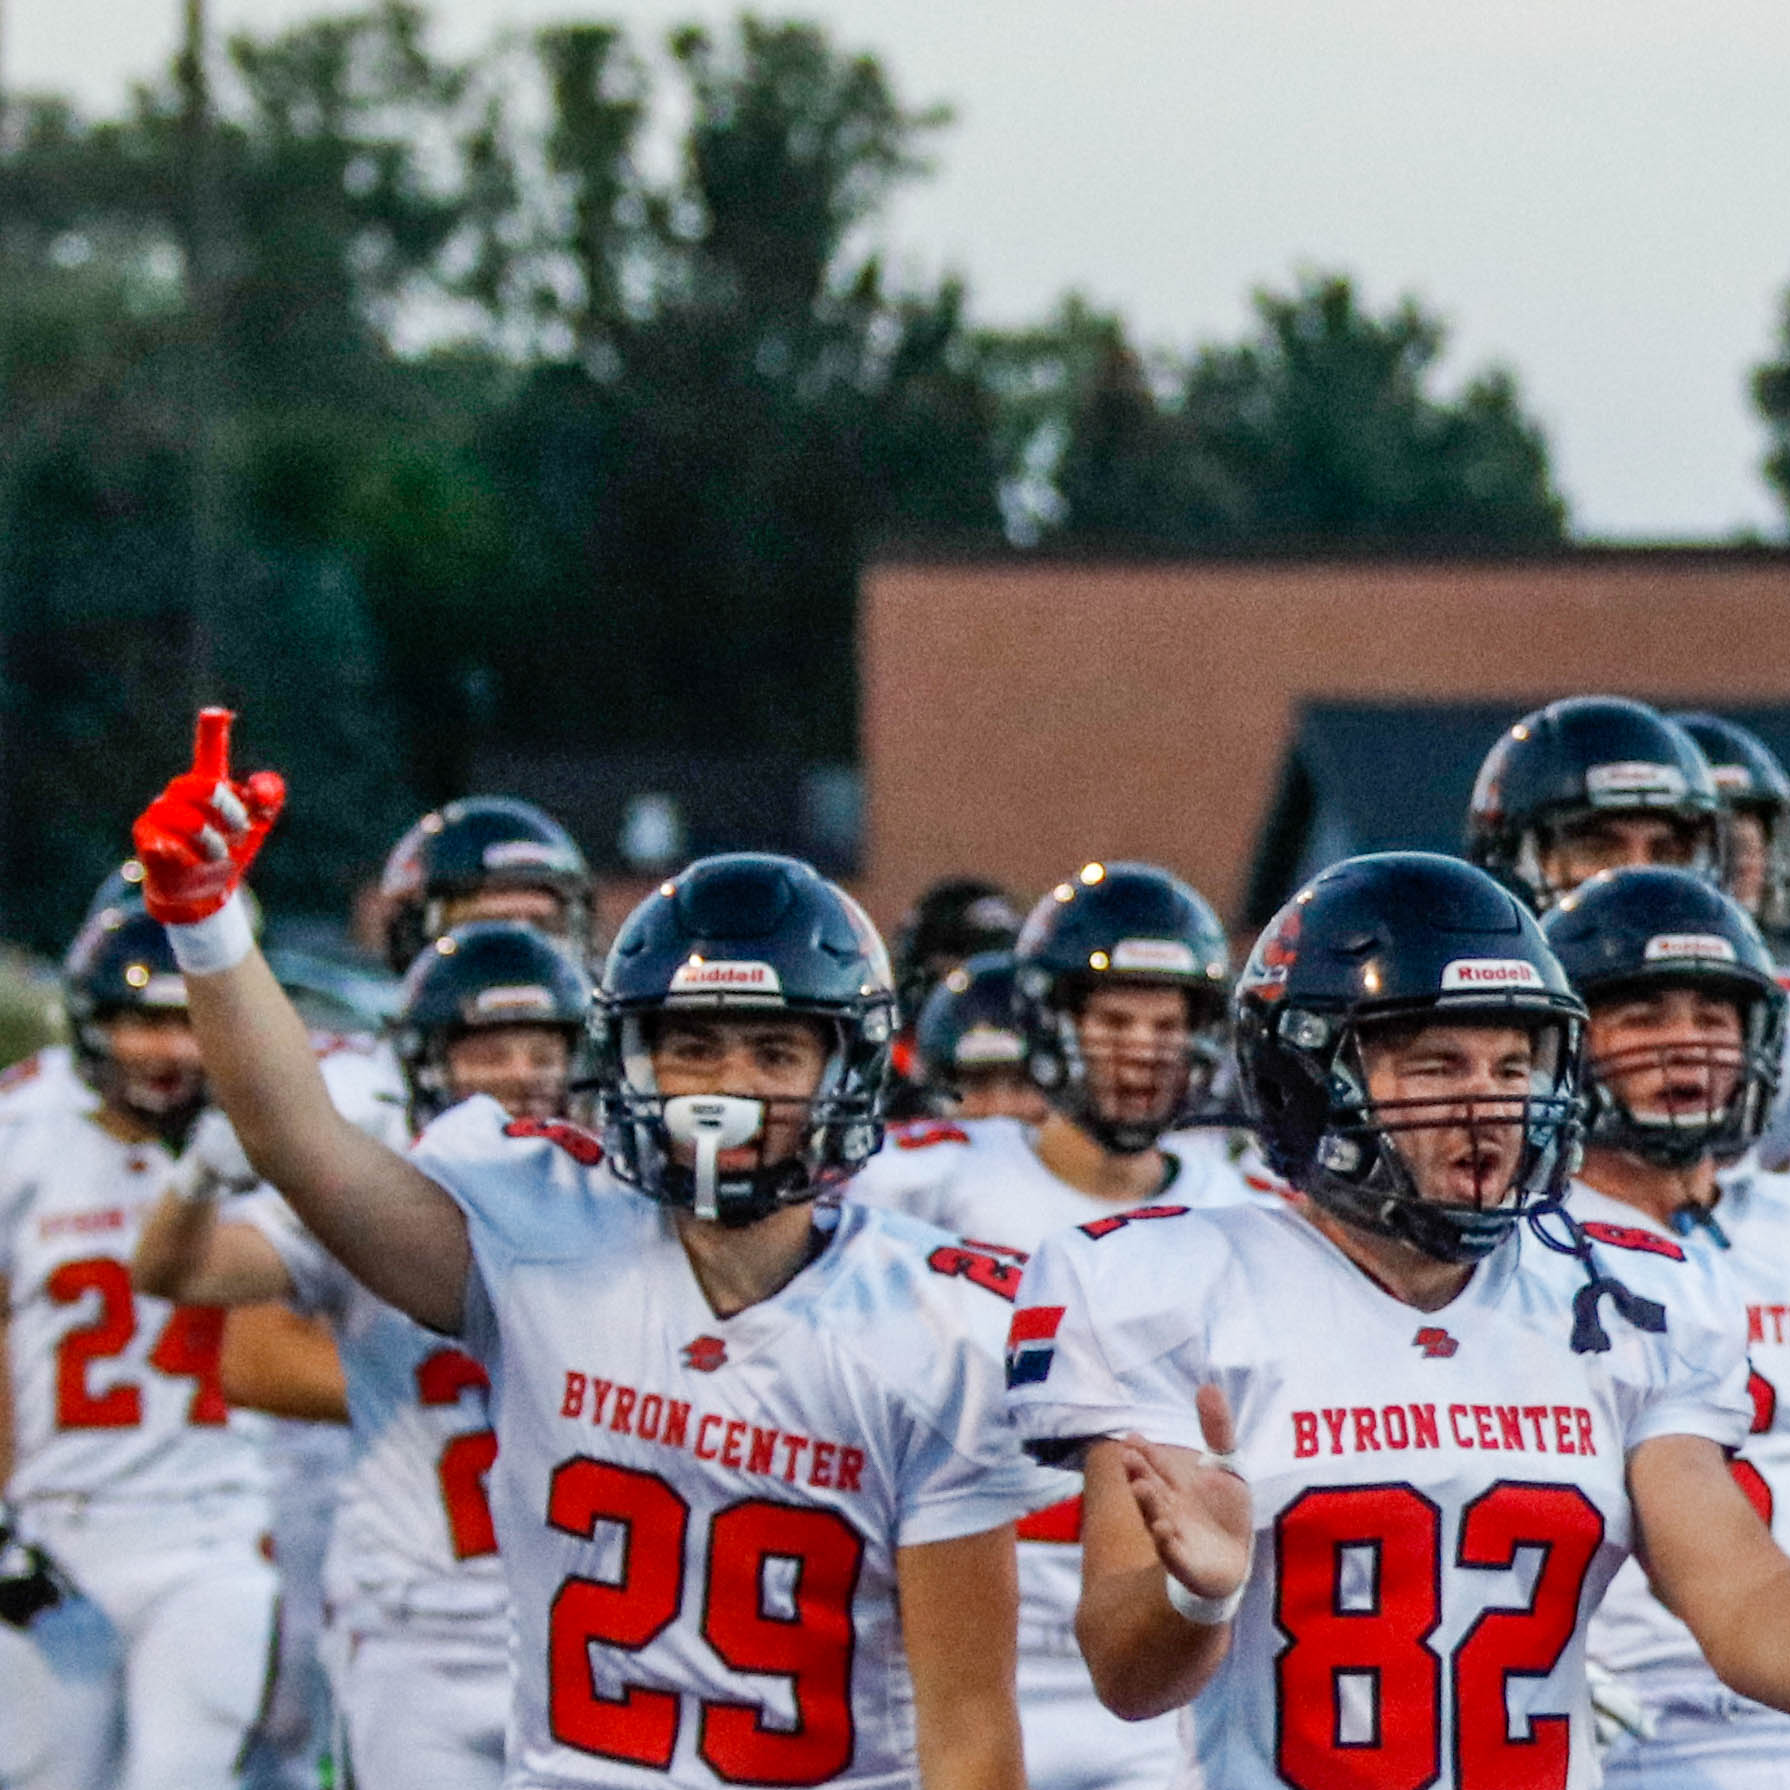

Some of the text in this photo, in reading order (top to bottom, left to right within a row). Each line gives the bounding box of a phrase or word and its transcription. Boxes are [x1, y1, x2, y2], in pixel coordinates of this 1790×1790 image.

[1457, 965, 1532, 982] Riddell
[46, 1256, 230, 1431] 24
[560, 1370, 867, 1493] BYRON CENTER
[1291, 1403, 1599, 1460] BYRON CENTER
[545, 1451, 867, 1789] 29
